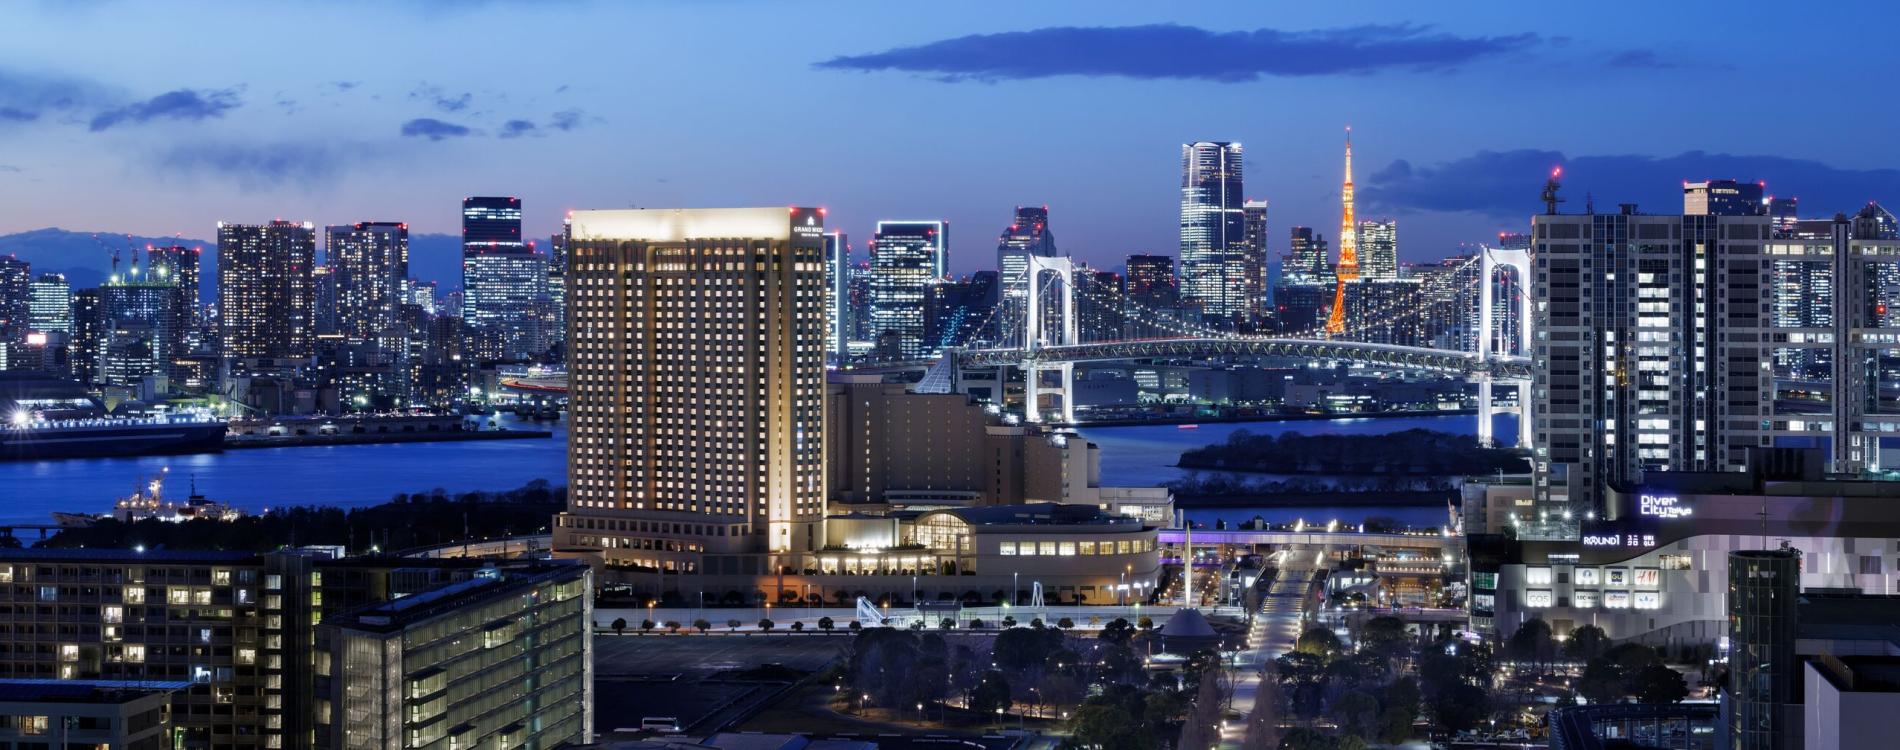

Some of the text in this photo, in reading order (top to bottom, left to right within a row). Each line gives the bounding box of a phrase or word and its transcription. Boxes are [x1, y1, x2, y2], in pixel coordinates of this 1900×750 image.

[1641, 495, 1677, 506] Diver
[1641, 504, 1667, 518] City
[1583, 534, 1620, 546] ROUND1
[1637, 570, 1657, 583] HM
